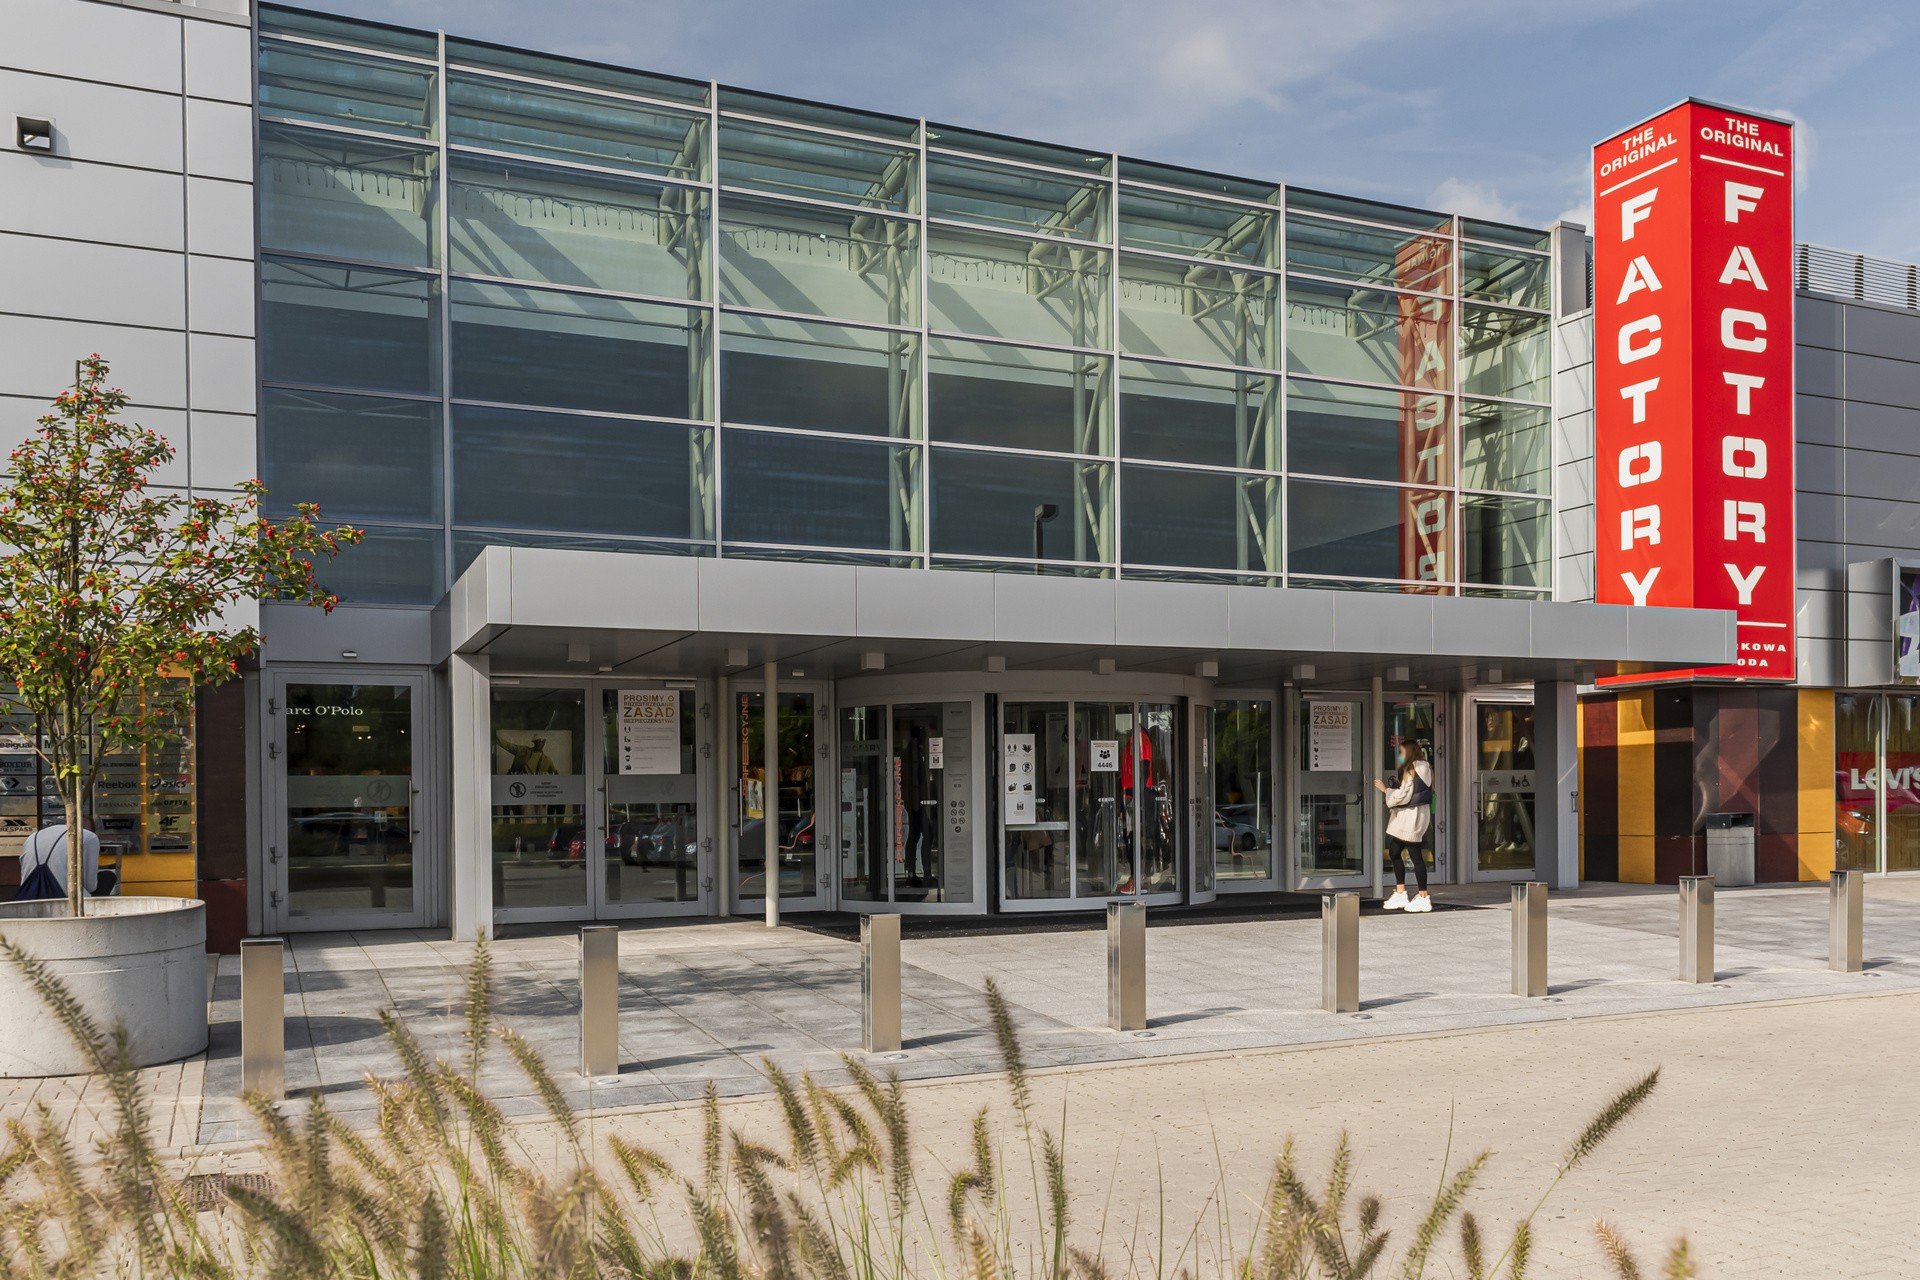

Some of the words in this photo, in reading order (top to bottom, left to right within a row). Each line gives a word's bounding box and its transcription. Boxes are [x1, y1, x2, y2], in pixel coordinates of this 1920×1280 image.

[1725, 117, 1759, 136] THE
[1622, 127, 1654, 151] THE
[1700, 127, 1783, 157] ORIGINAL
[1600, 132, 1677, 177] ORIGINAL
[1616, 187, 1663, 606] FACTORY
[1718, 180, 1769, 606] FACTORY
[1737, 642, 1786, 652] KOWA
[1737, 658, 1769, 667] ODA
[286, 707, 311, 715] arc
[315, 706, 363, 715] O'Polo
[623, 707, 675, 718] ZASAD
[1313, 715, 1348, 724] ZASAD
[98, 780, 138, 788] Reebok
[162, 780, 186, 788] asics
[159, 816, 180, 826] 4F
